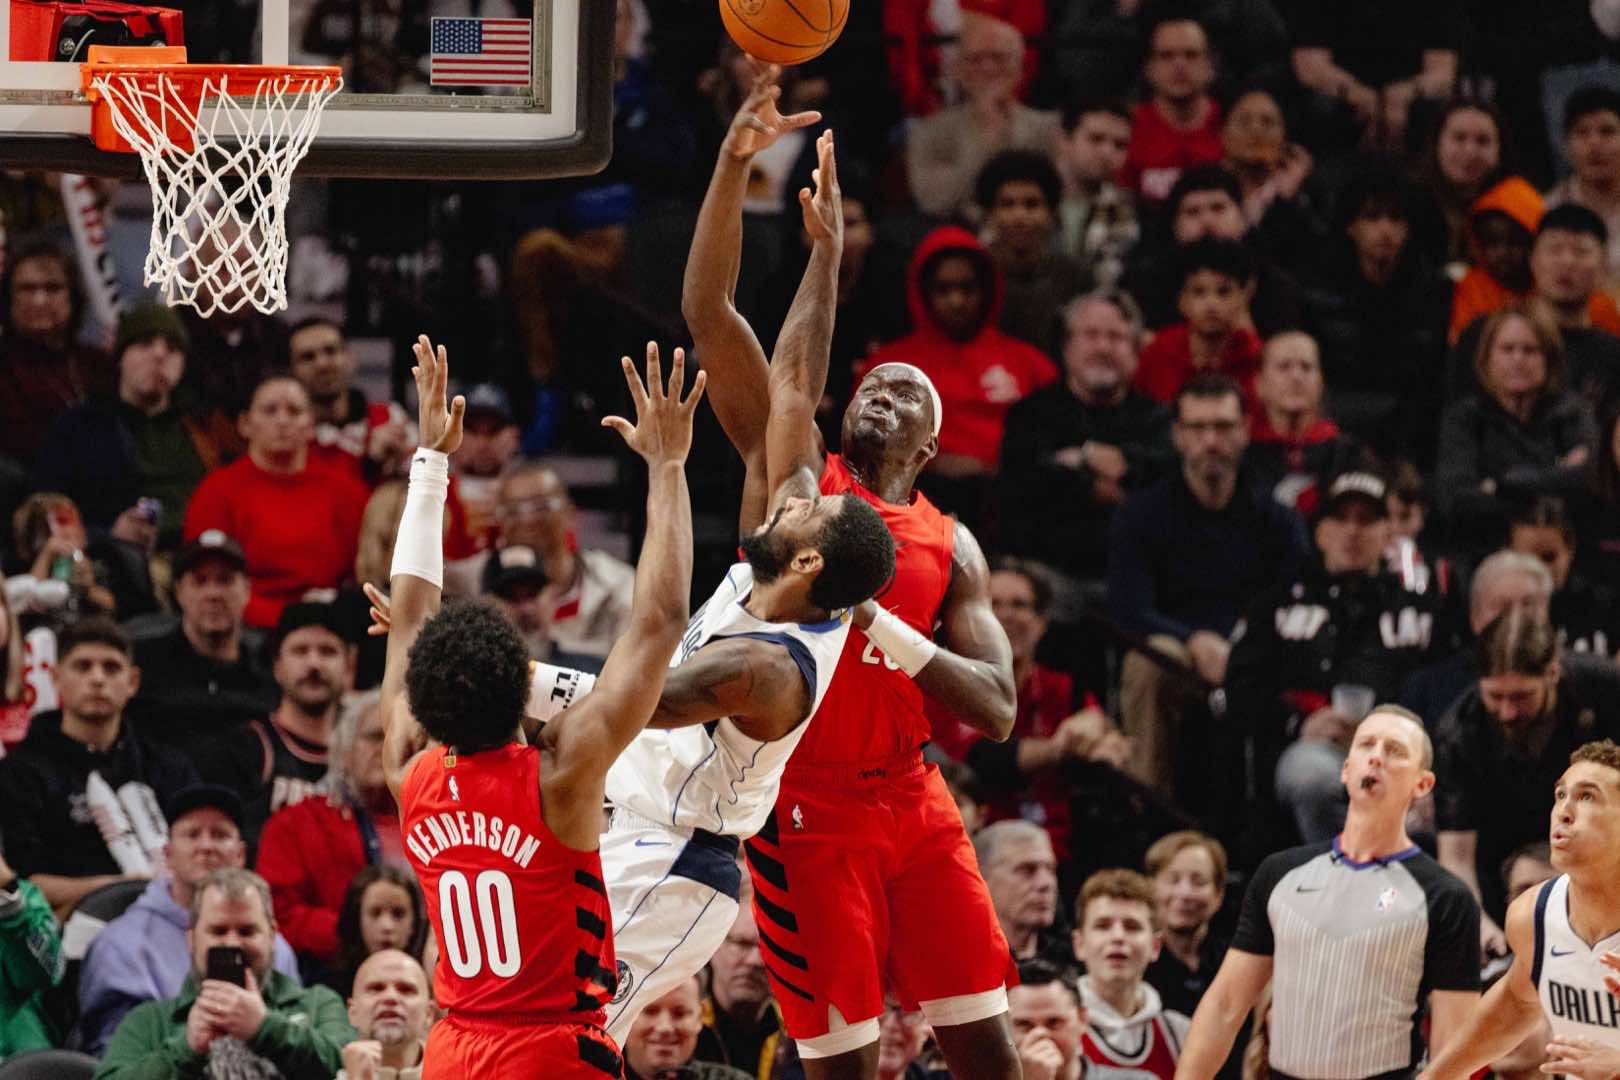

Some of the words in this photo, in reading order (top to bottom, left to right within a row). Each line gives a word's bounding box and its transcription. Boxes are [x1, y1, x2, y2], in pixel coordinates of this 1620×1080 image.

[551, 672, 572, 703] 11
[406, 810, 542, 870] HENDERSON
[438, 869, 522, 978] 00
